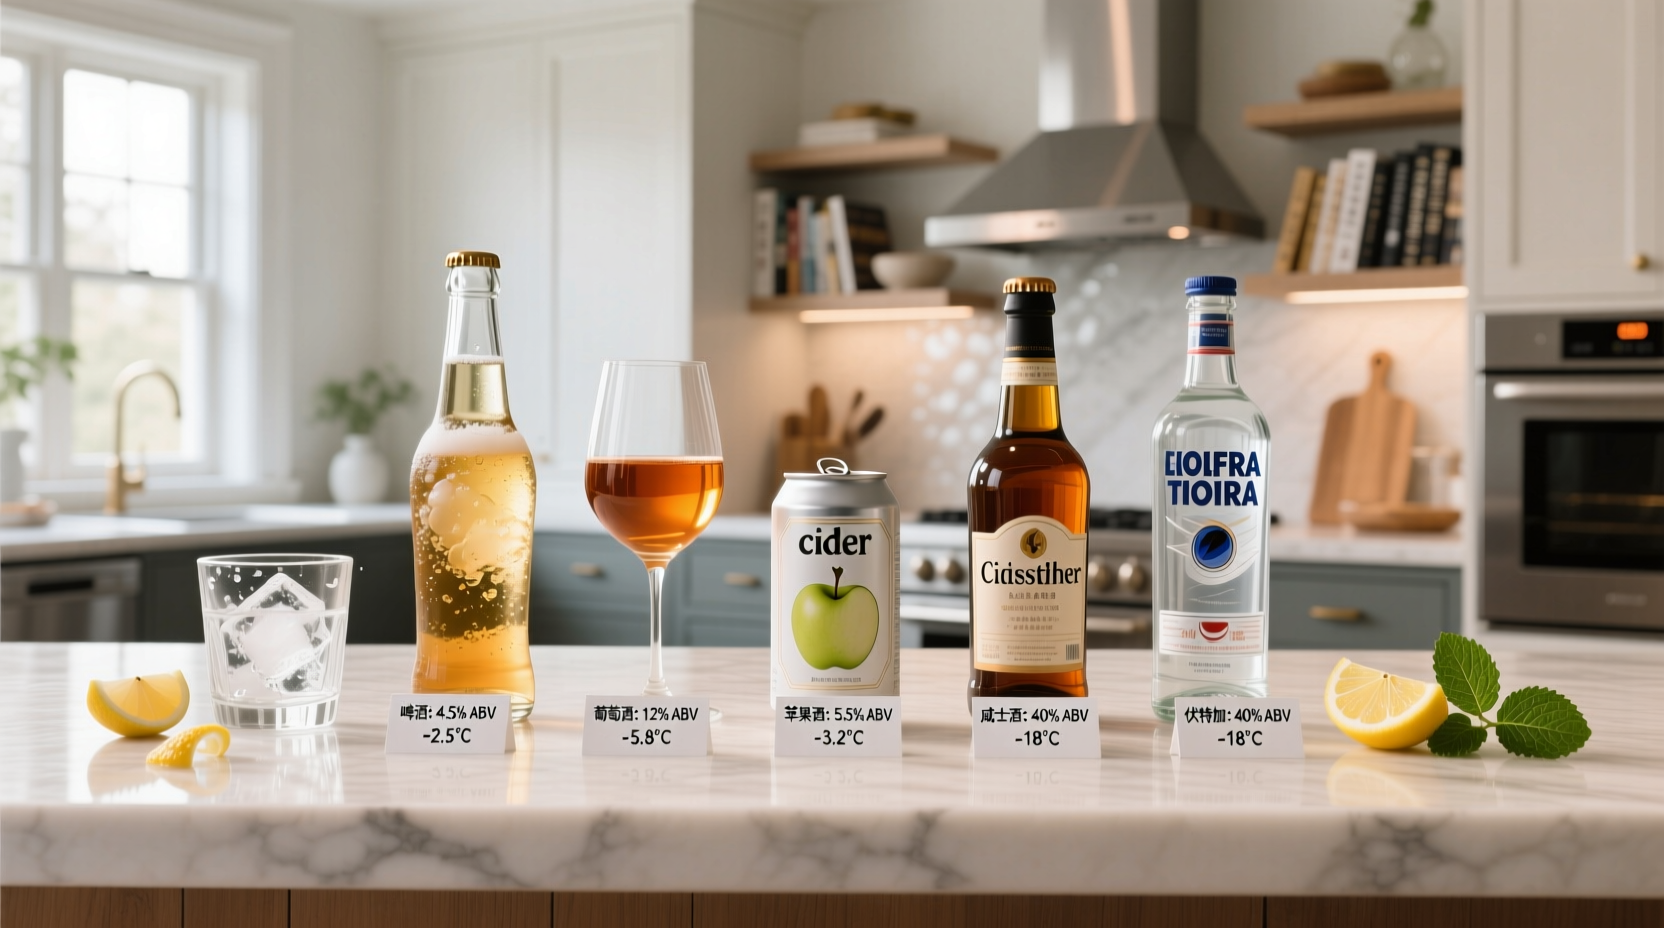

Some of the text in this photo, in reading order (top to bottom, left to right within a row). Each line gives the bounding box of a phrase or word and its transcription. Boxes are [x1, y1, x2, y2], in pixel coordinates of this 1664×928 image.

[1167, 480, 1258, 506] TIOIRA
[798, 526, 872, 555] cider
[469, 705, 497, 720] ABV
[642, 707, 669, 721] 12%
[671, 707, 699, 721] ABV
[834, 707, 865, 721] 5.5%
[866, 707, 893, 721] ABV
[1031, 708, 1060, 722] 40%
[1062, 708, 1089, 722] ABV
[1234, 708, 1263, 722] 40%
[1264, 708, 1291, 722] ABV
